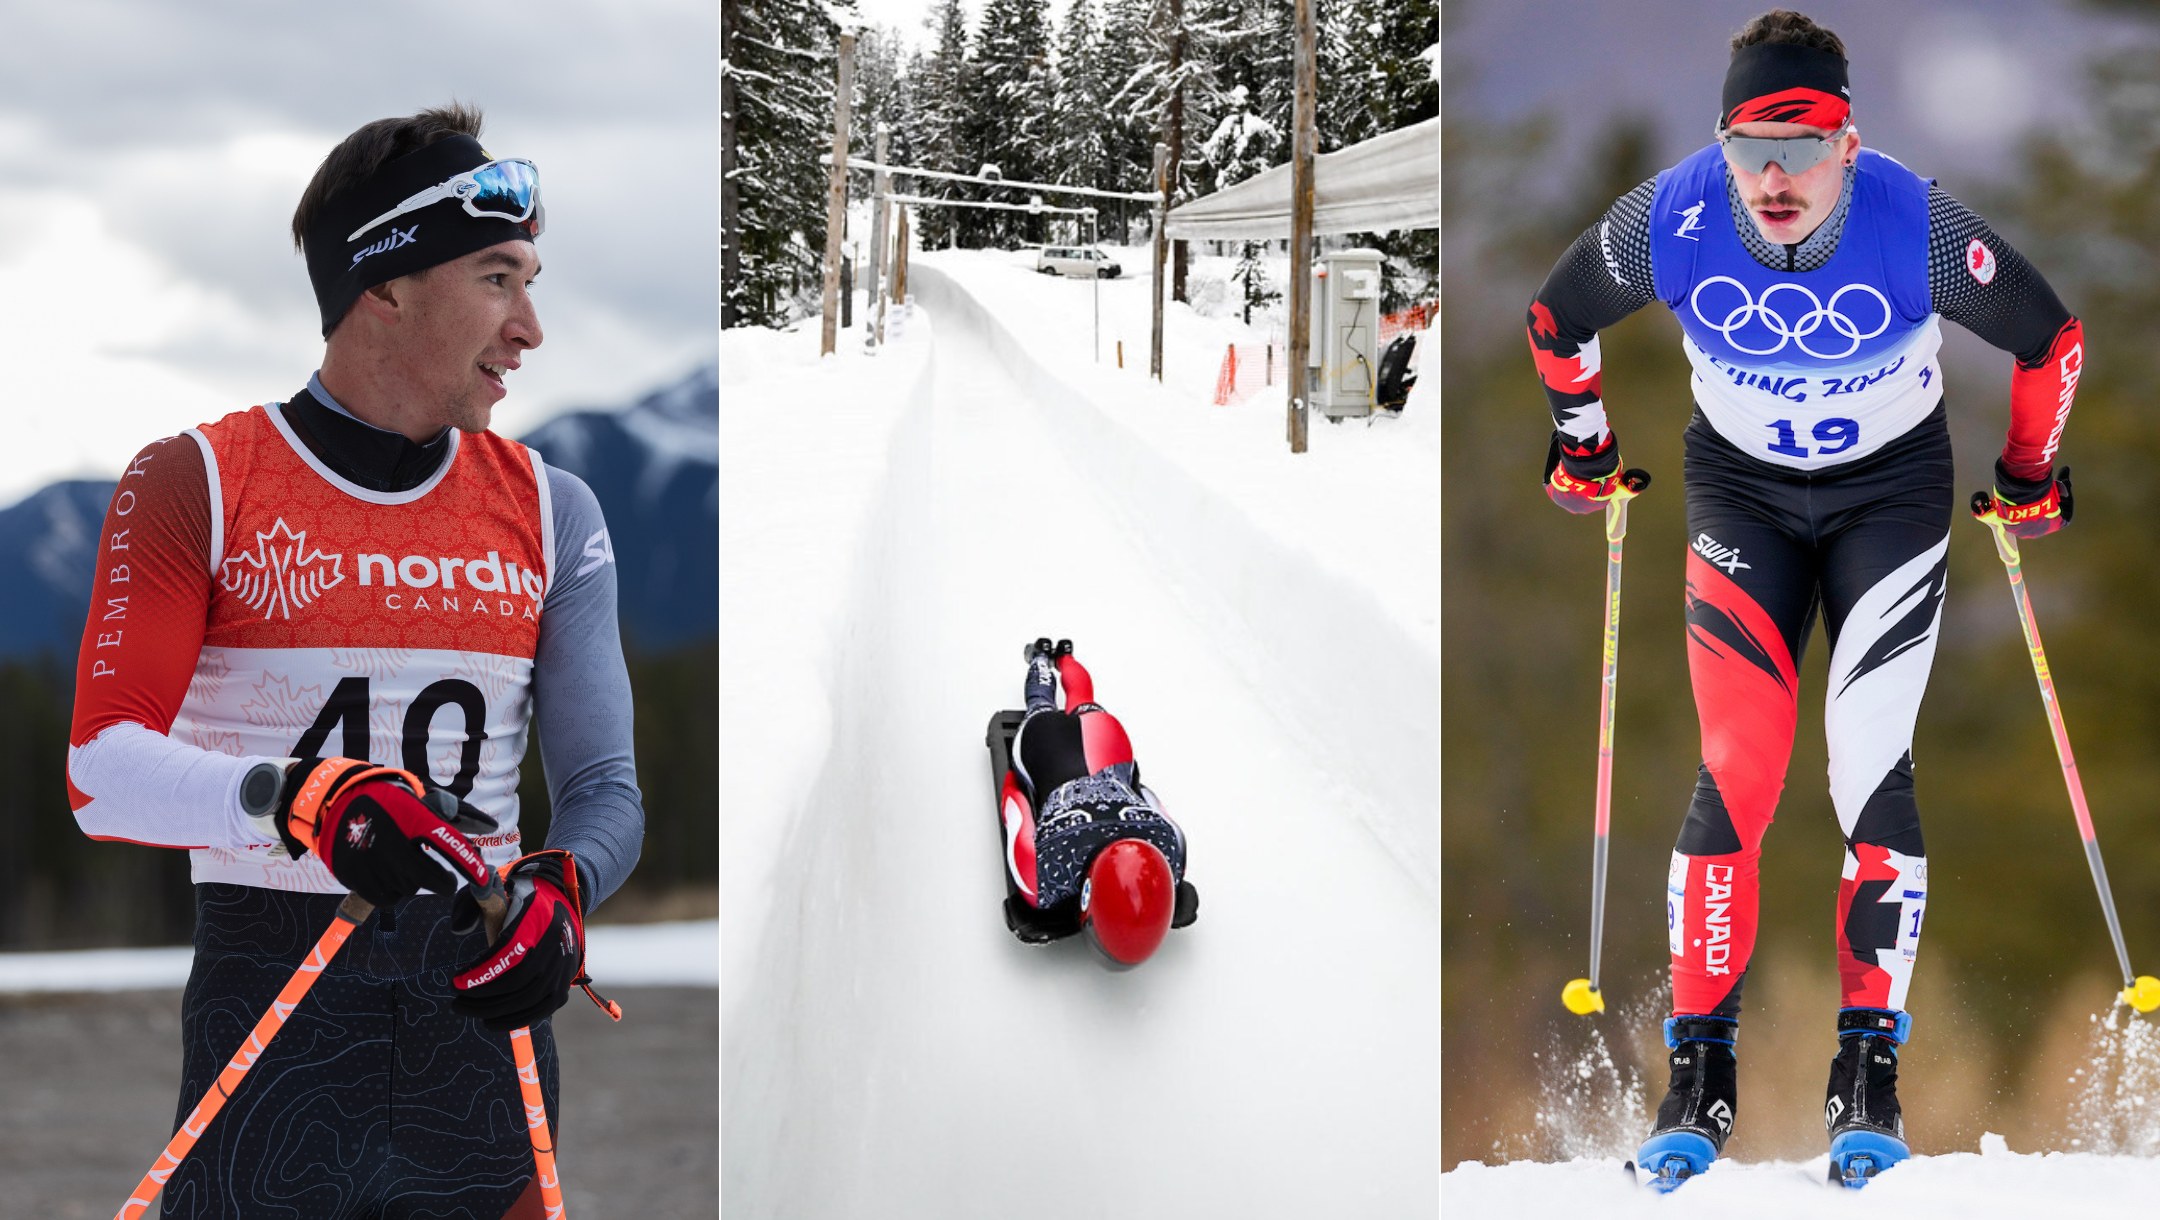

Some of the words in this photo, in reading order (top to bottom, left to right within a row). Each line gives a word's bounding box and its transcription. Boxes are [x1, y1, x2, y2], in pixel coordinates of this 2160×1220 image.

[1765, 417, 1860, 459] 19
[2034, 342, 2083, 466] CANADA
[2008, 498, 2052, 520] LEKI
[385, 594, 535, 622] CANADA
[289, 677, 488, 801] 40
[1705, 864, 1734, 977] CANADA
